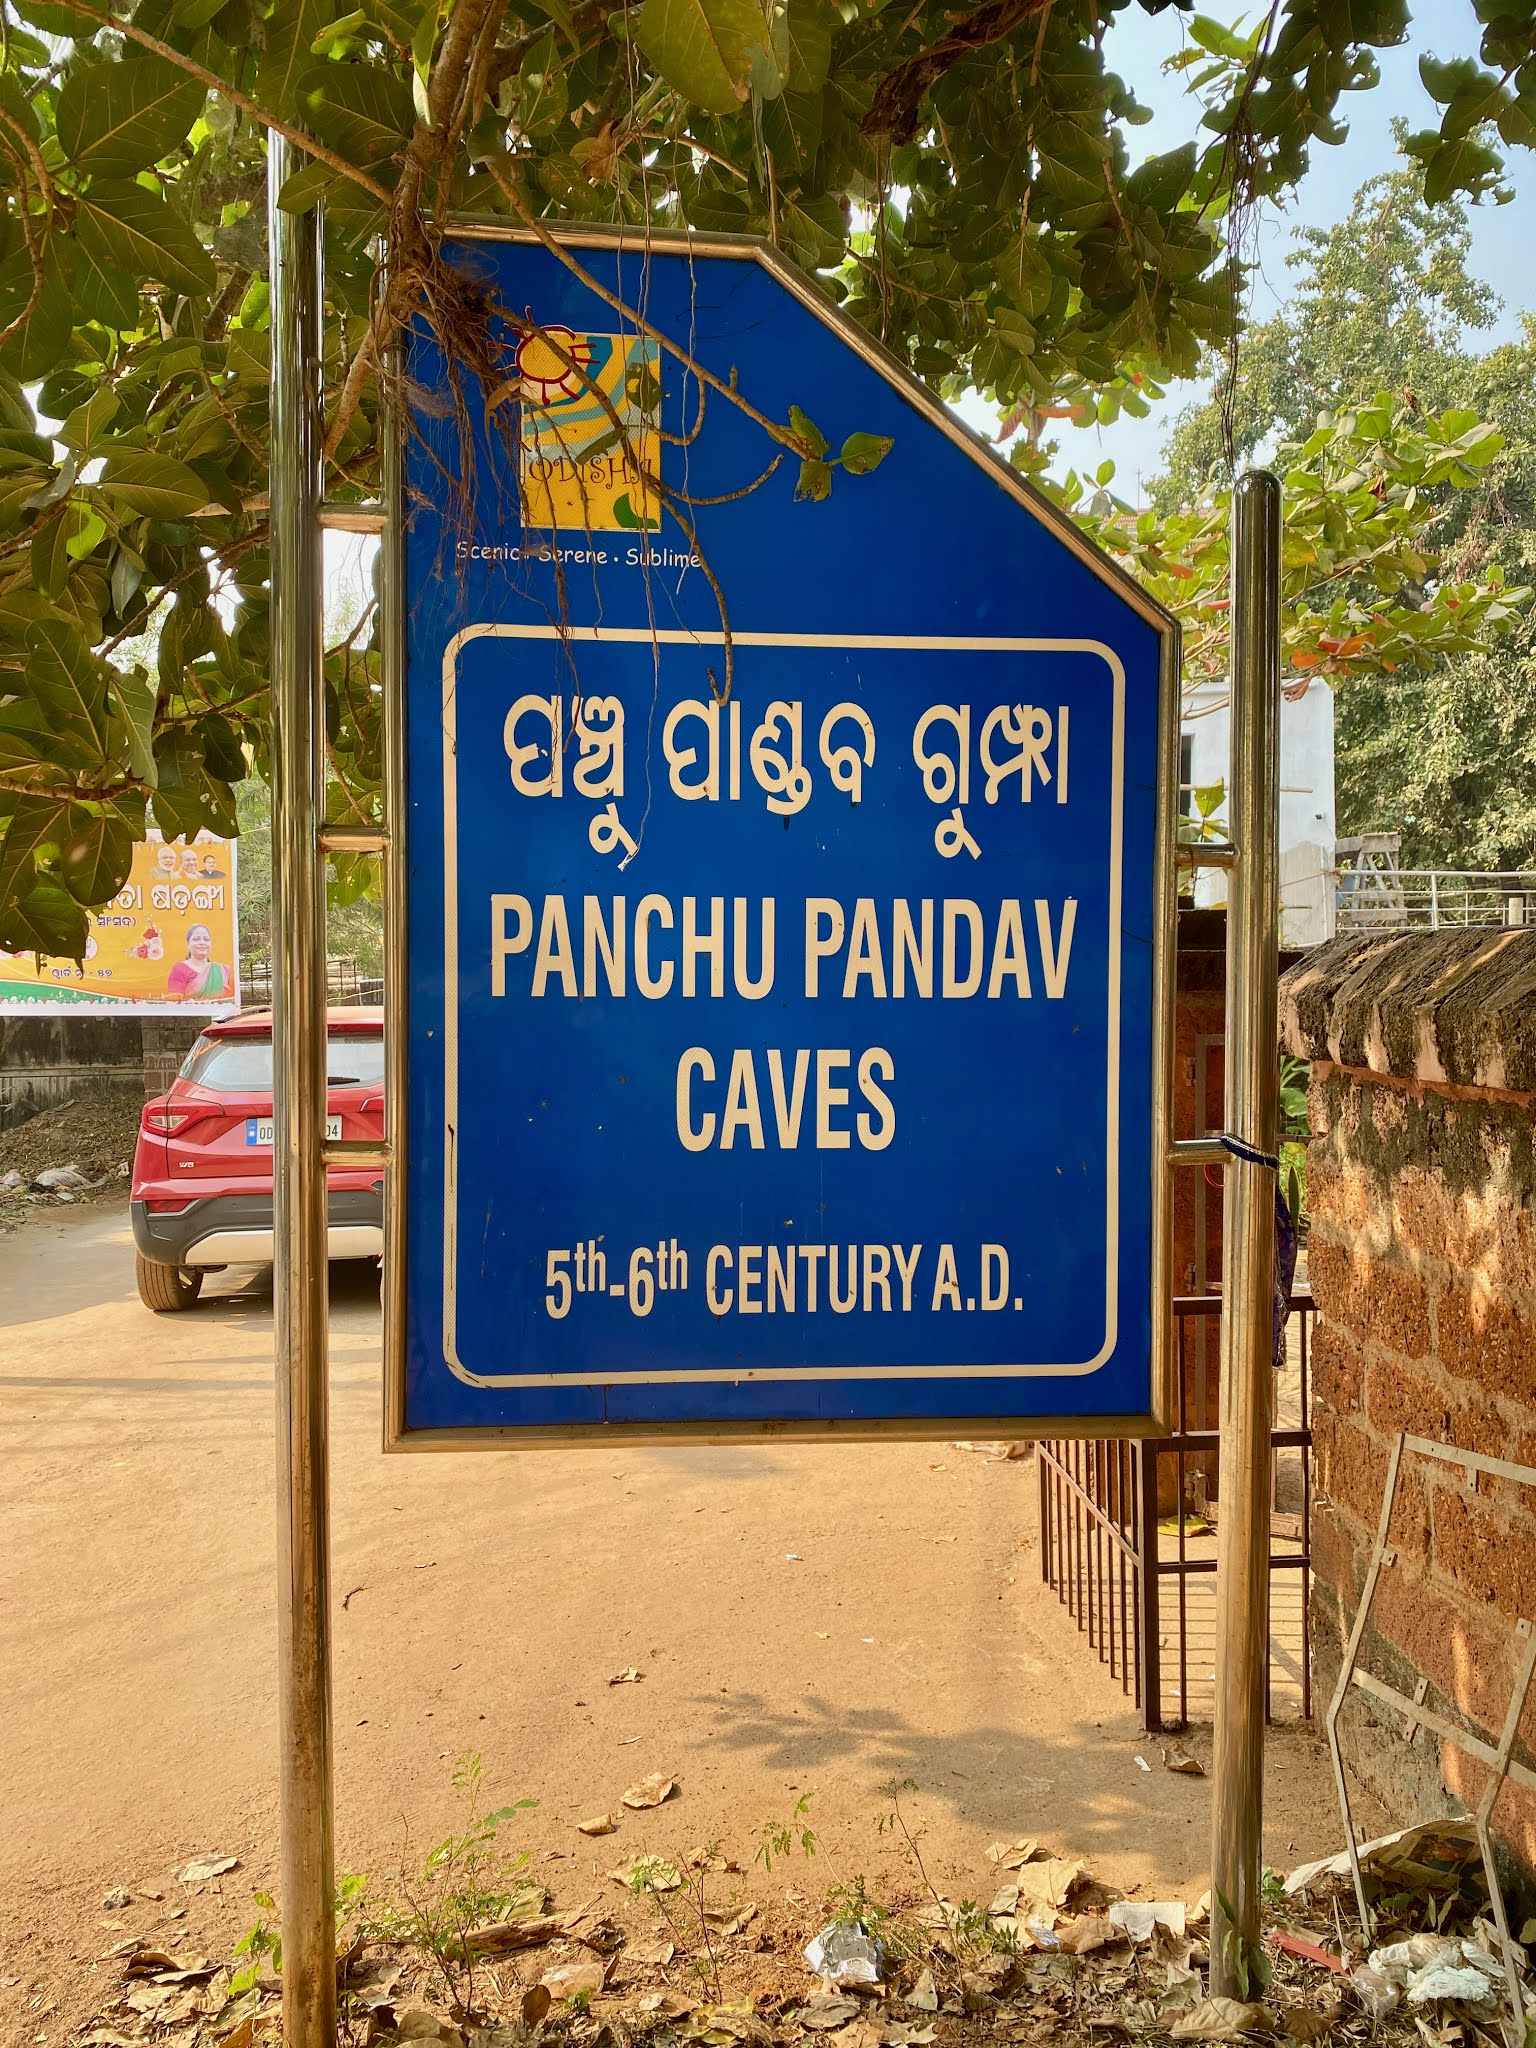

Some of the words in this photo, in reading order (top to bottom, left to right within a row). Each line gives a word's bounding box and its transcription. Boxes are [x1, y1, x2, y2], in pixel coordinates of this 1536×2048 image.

[456, 541, 520, 561] Scenic
[625, 547, 701, 568] Sublime
[662, 699, 876, 816] ପାଣ୍ଡବ
[912, 703, 1069, 860] ଗୁମ୍ଫା
[491, 894, 775, 1000] PANCHU
[805, 897, 1078, 999] PANDAV
[676, 1047, 896, 1152] CAVES
[545, 1239, 688, 1319] 5th-6th
[706, 1245, 923, 1315] CENTURY
[931, 1244, 1023, 1311] A.D.
